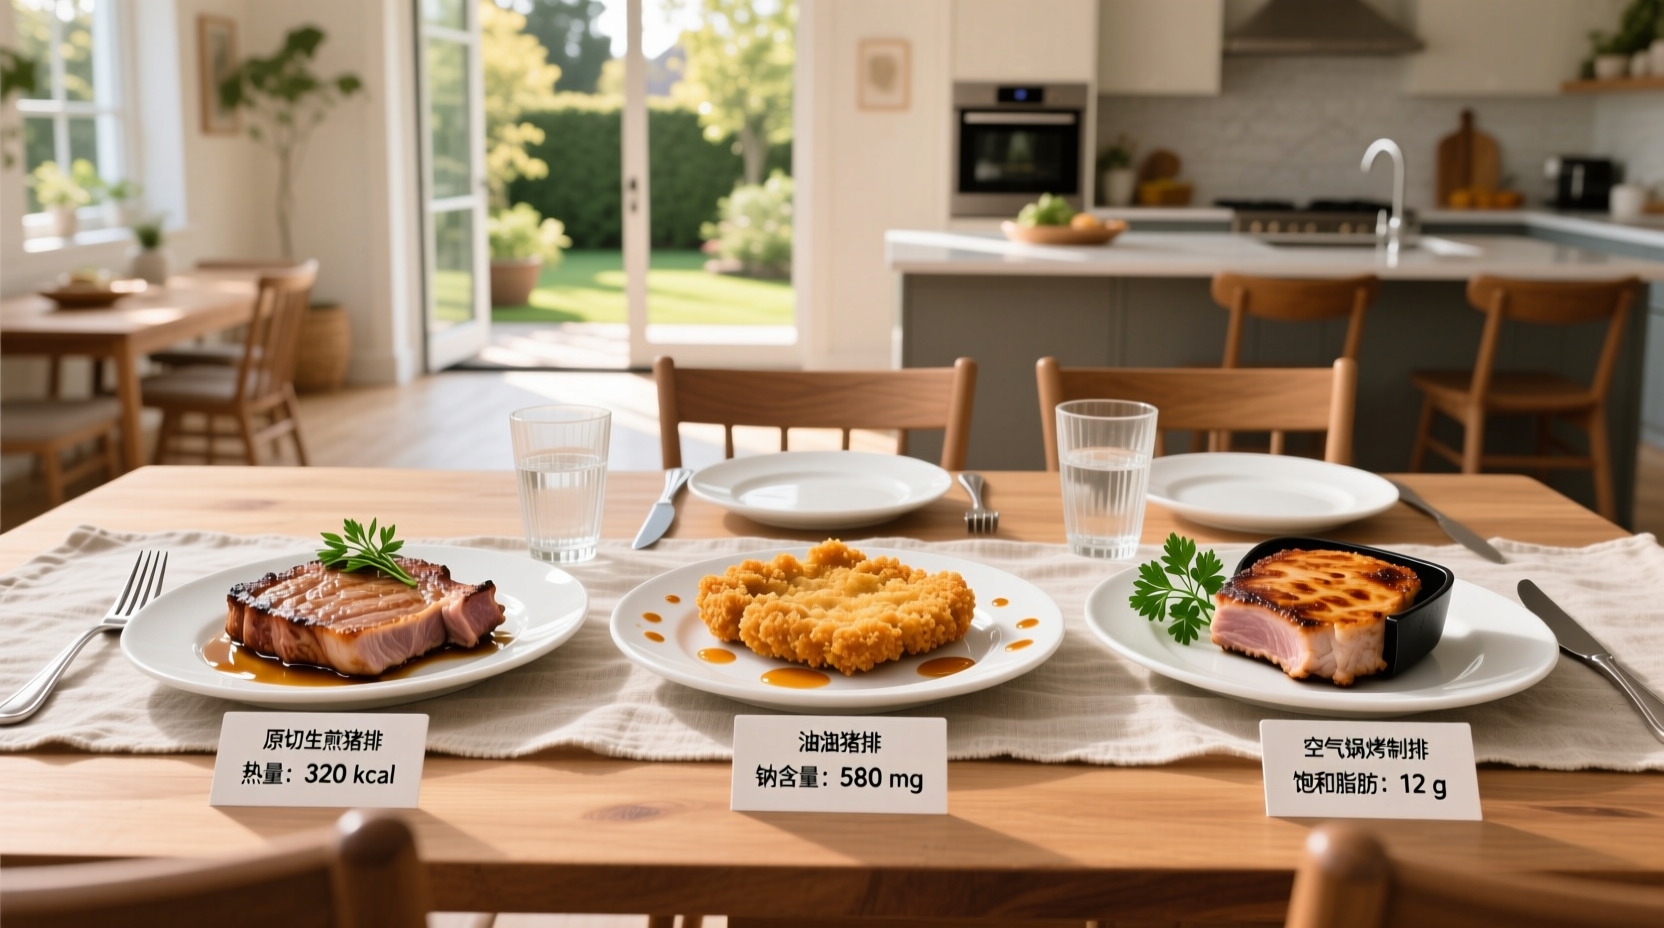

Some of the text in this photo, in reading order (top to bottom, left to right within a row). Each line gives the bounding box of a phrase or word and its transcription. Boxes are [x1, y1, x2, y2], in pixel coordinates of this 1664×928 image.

[262, 728, 384, 752] 原切生煎猪排
[304, 763, 347, 784] 320
[353, 764, 396, 785] kcal
[840, 766, 883, 788] 580
[889, 772, 924, 794] mg
[1400, 773, 1426, 794] 12
[1432, 779, 1447, 800] g
